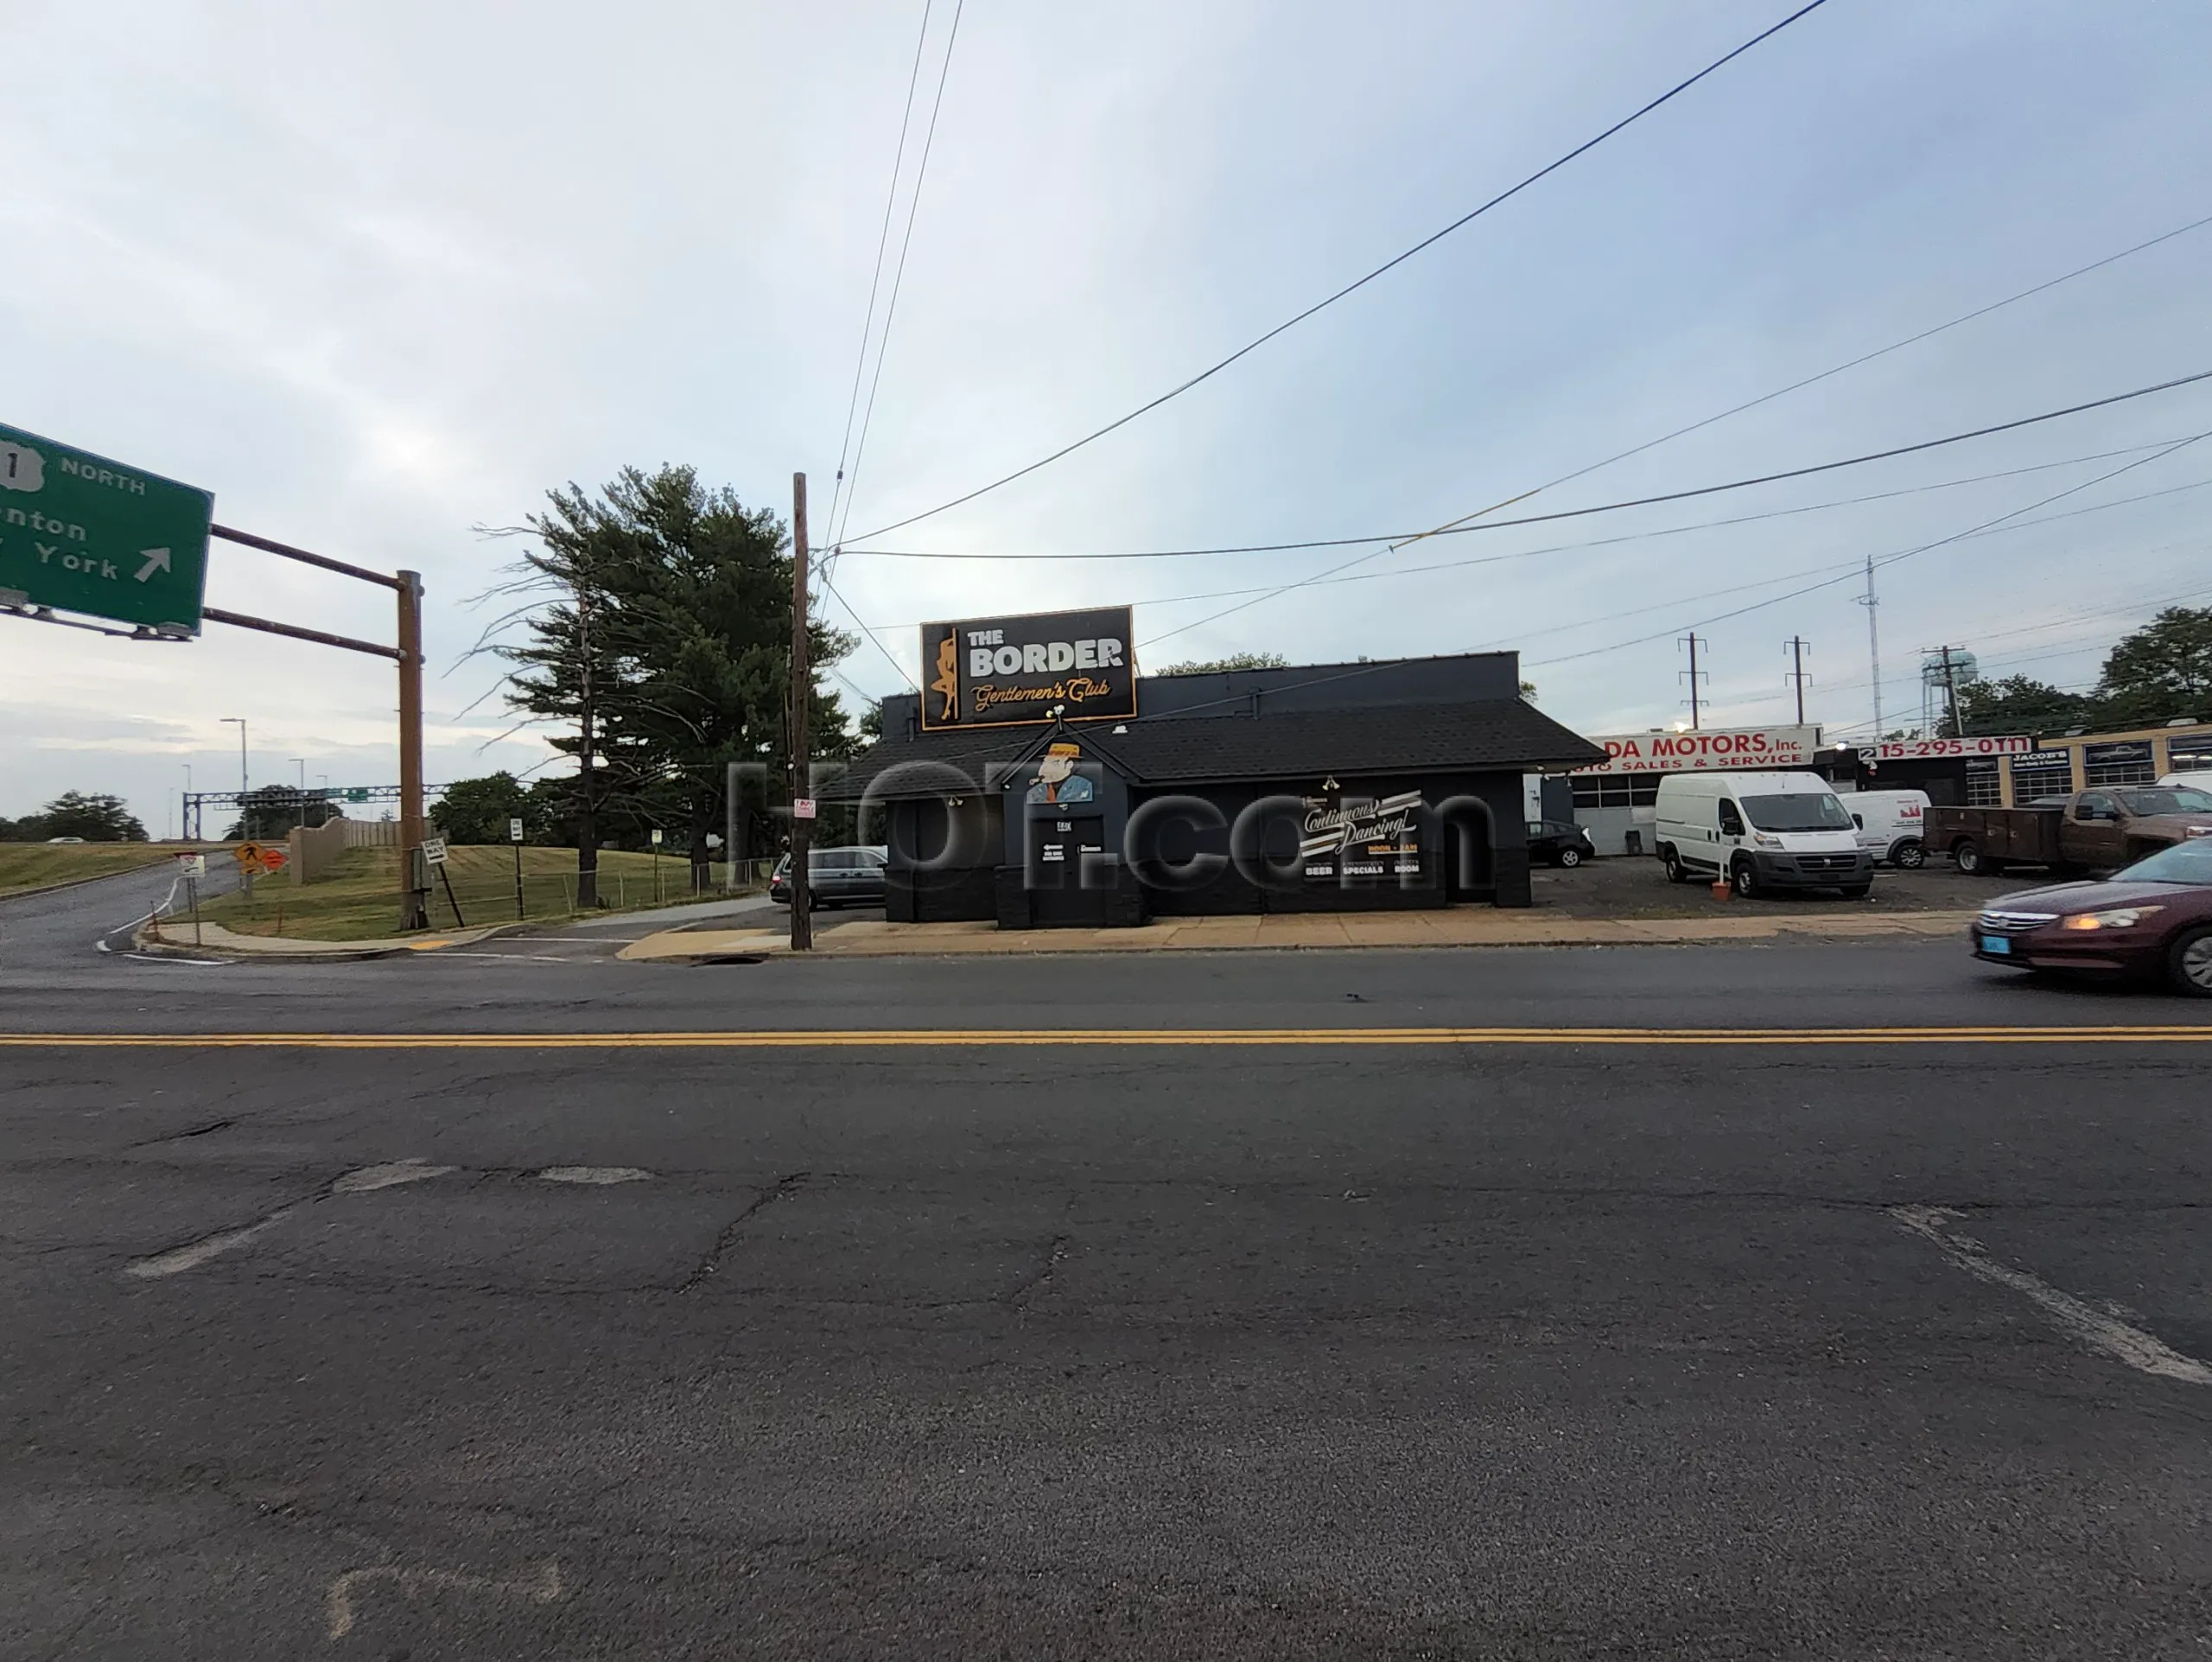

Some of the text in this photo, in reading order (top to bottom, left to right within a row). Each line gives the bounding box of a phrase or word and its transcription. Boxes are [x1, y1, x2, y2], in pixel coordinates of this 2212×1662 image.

[7, 452, 18, 478] 1
[61, 456, 146, 495] NORTH
[0, 507, 87, 541] nton
[34, 541, 118, 580] York
[967, 629, 1005, 647] THE
[969, 638, 1124, 678] BORDER
[970, 678, 1111, 712] Gentlemen's Club
[1776, 738, 1802, 751] Inc.
[2013, 750, 2068, 761] JACOB'S
[1622, 760, 1682, 771] SALES
[1694, 758, 1708, 767] &
[1719, 754, 1802, 767] SERVICE
[1305, 800, 1380, 832] Continuous
[425, 839, 442, 848] ONE
[1335, 809, 1417, 855] Dancing!
[427, 846, 444, 855] WAY
[1306, 864, 1420, 876] BEER SPECIALS ROOM
